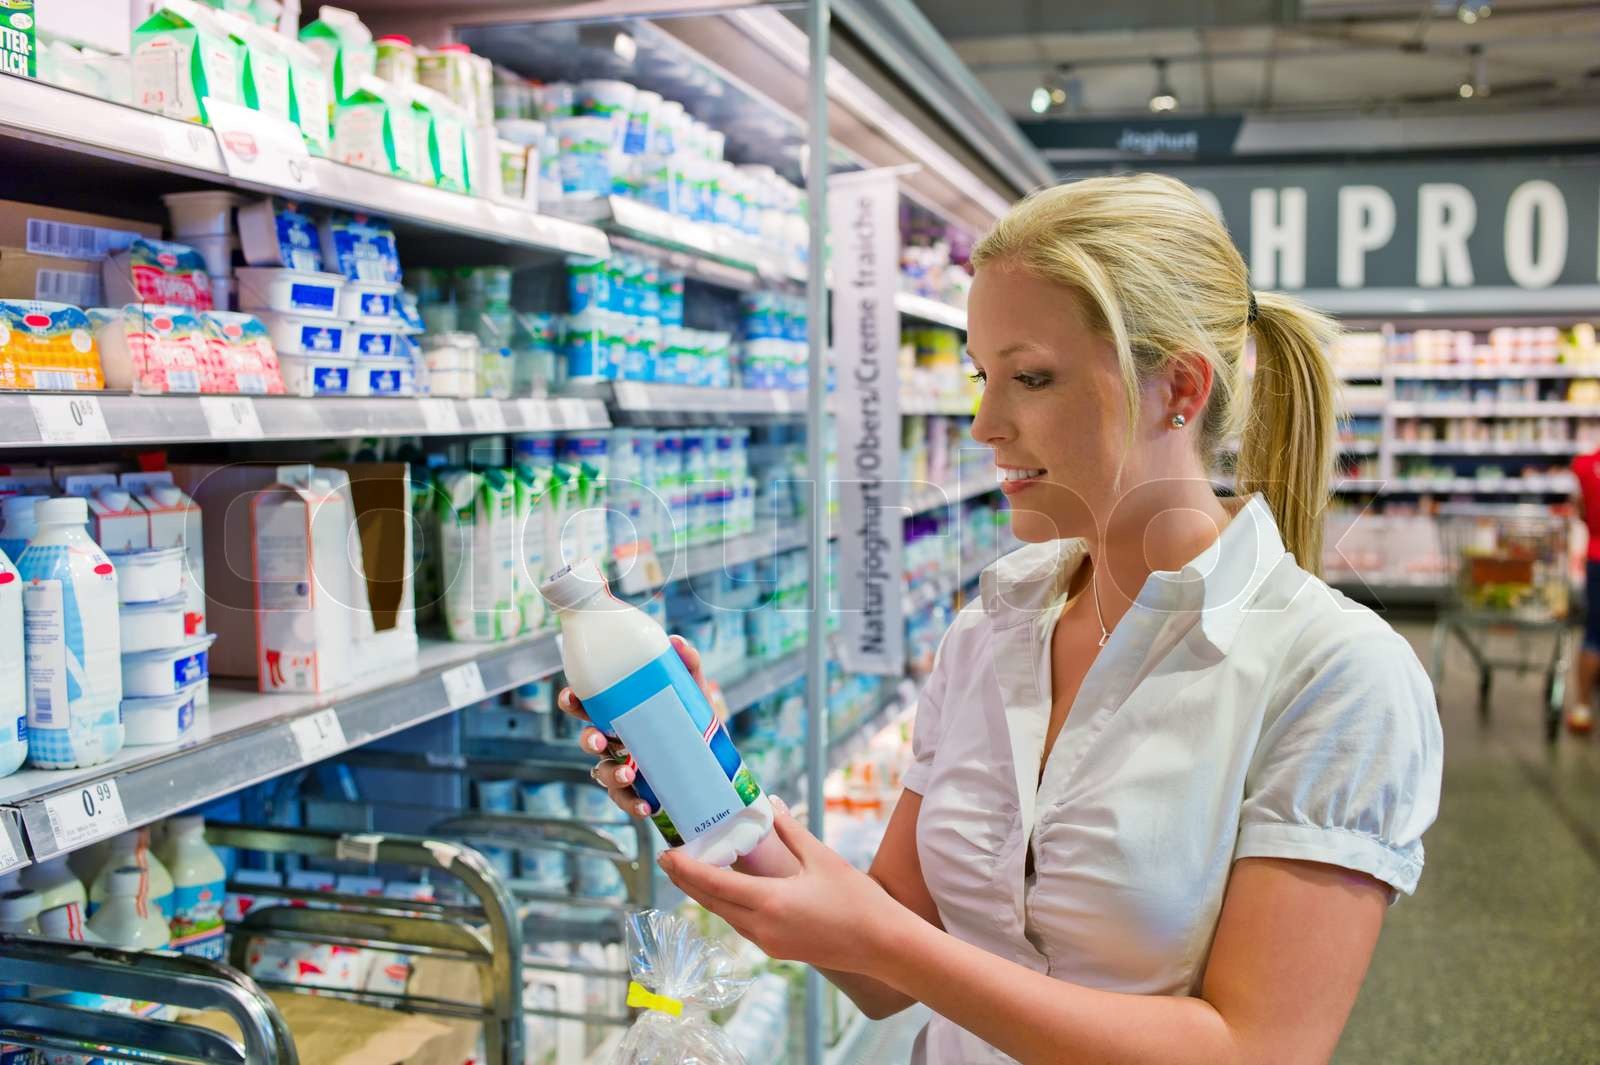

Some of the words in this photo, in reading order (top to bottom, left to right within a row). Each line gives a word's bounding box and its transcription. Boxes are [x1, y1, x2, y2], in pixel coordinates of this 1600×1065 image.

[1117, 129, 1198, 156] Joghurt
[1195, 179, 1600, 289] HPRO
[694, 820, 711, 833] 0,75
[711, 809, 730, 823] Liter
